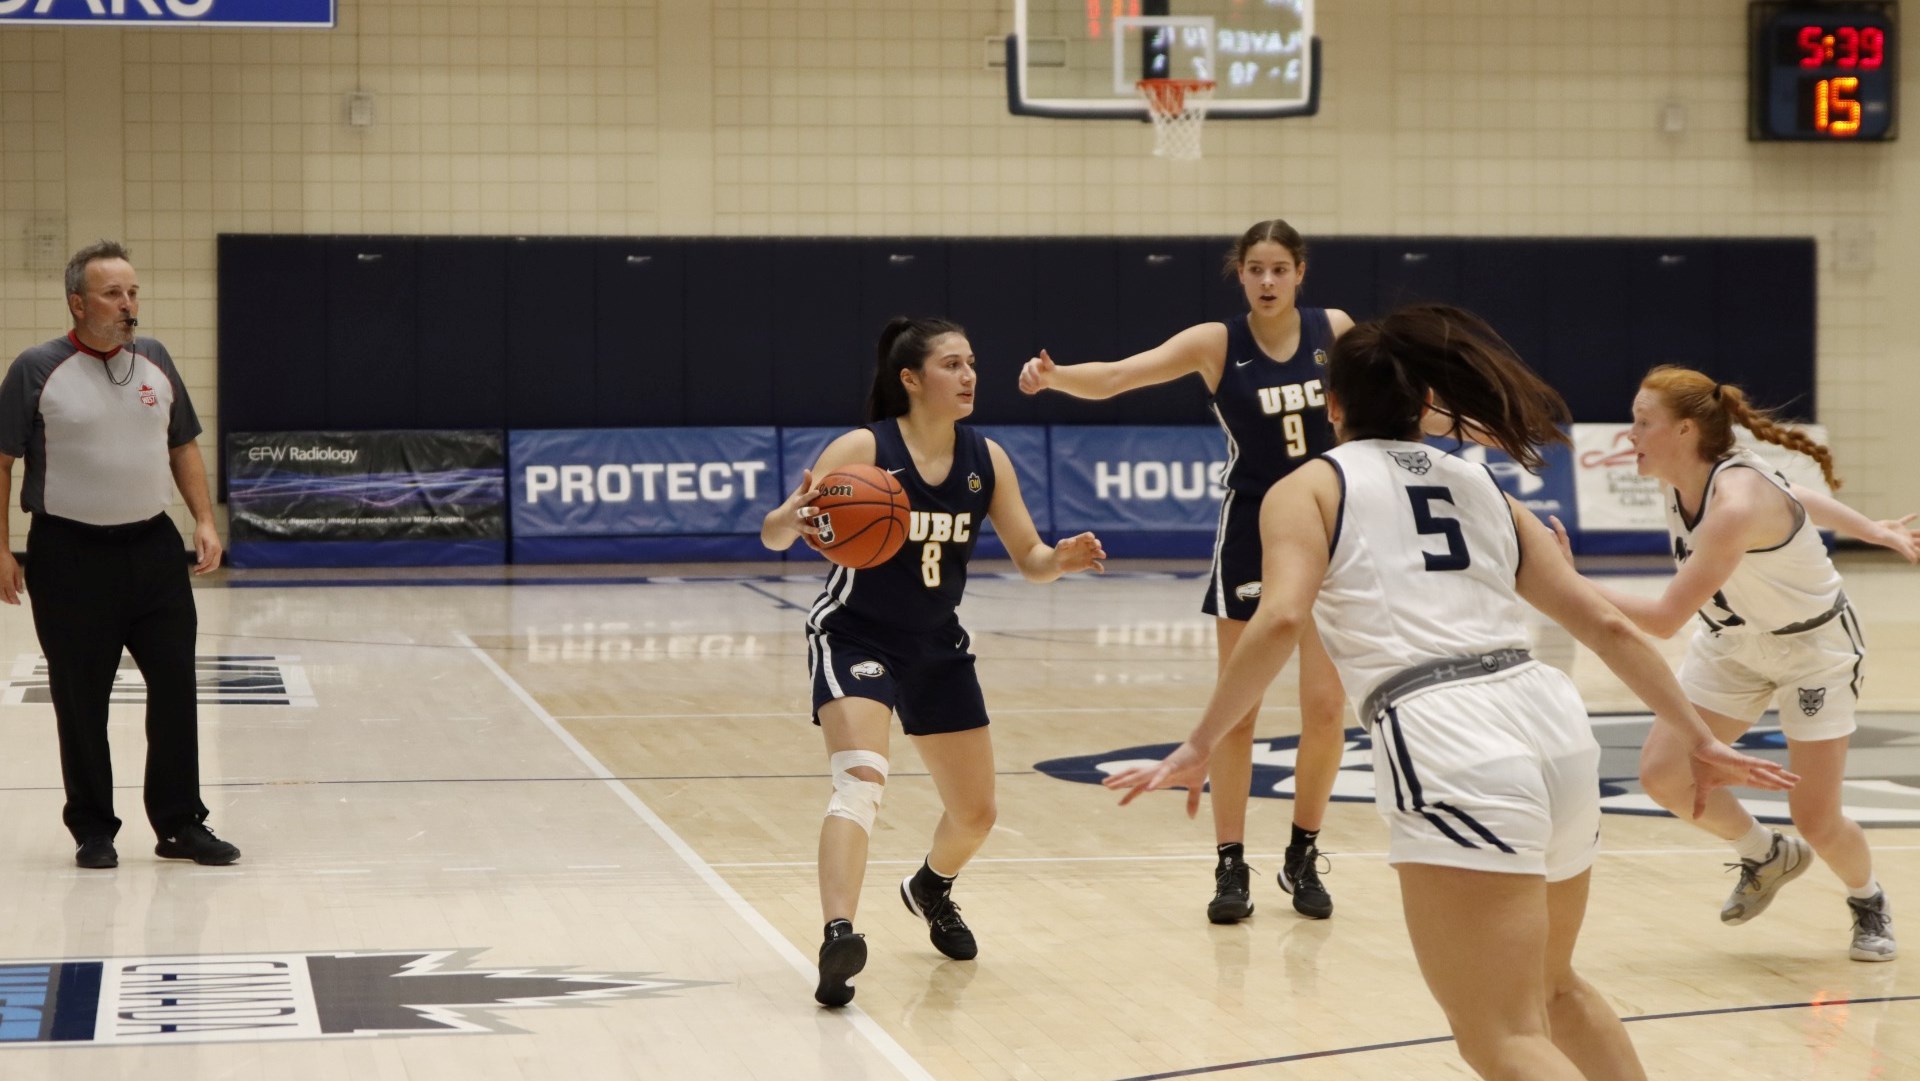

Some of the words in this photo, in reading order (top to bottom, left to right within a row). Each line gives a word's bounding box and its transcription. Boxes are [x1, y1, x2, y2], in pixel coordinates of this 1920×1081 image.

[1798, 26, 1884, 70] 5:39
[1815, 76, 1861, 137] 15
[1258, 379, 1326, 415] UBC
[290, 445, 358, 465] Radiology
[1282, 413, 1307, 457] 9
[525, 461, 766, 504] PROTECT
[1095, 461, 1227, 500] HOUS
[289, 517, 326, 526] diagnostic
[328, 517, 356, 526] imaging
[358, 516, 388, 526] provider
[909, 511, 971, 543] UBC
[1405, 485, 1471, 572] 5
[921, 542, 943, 588] 8
